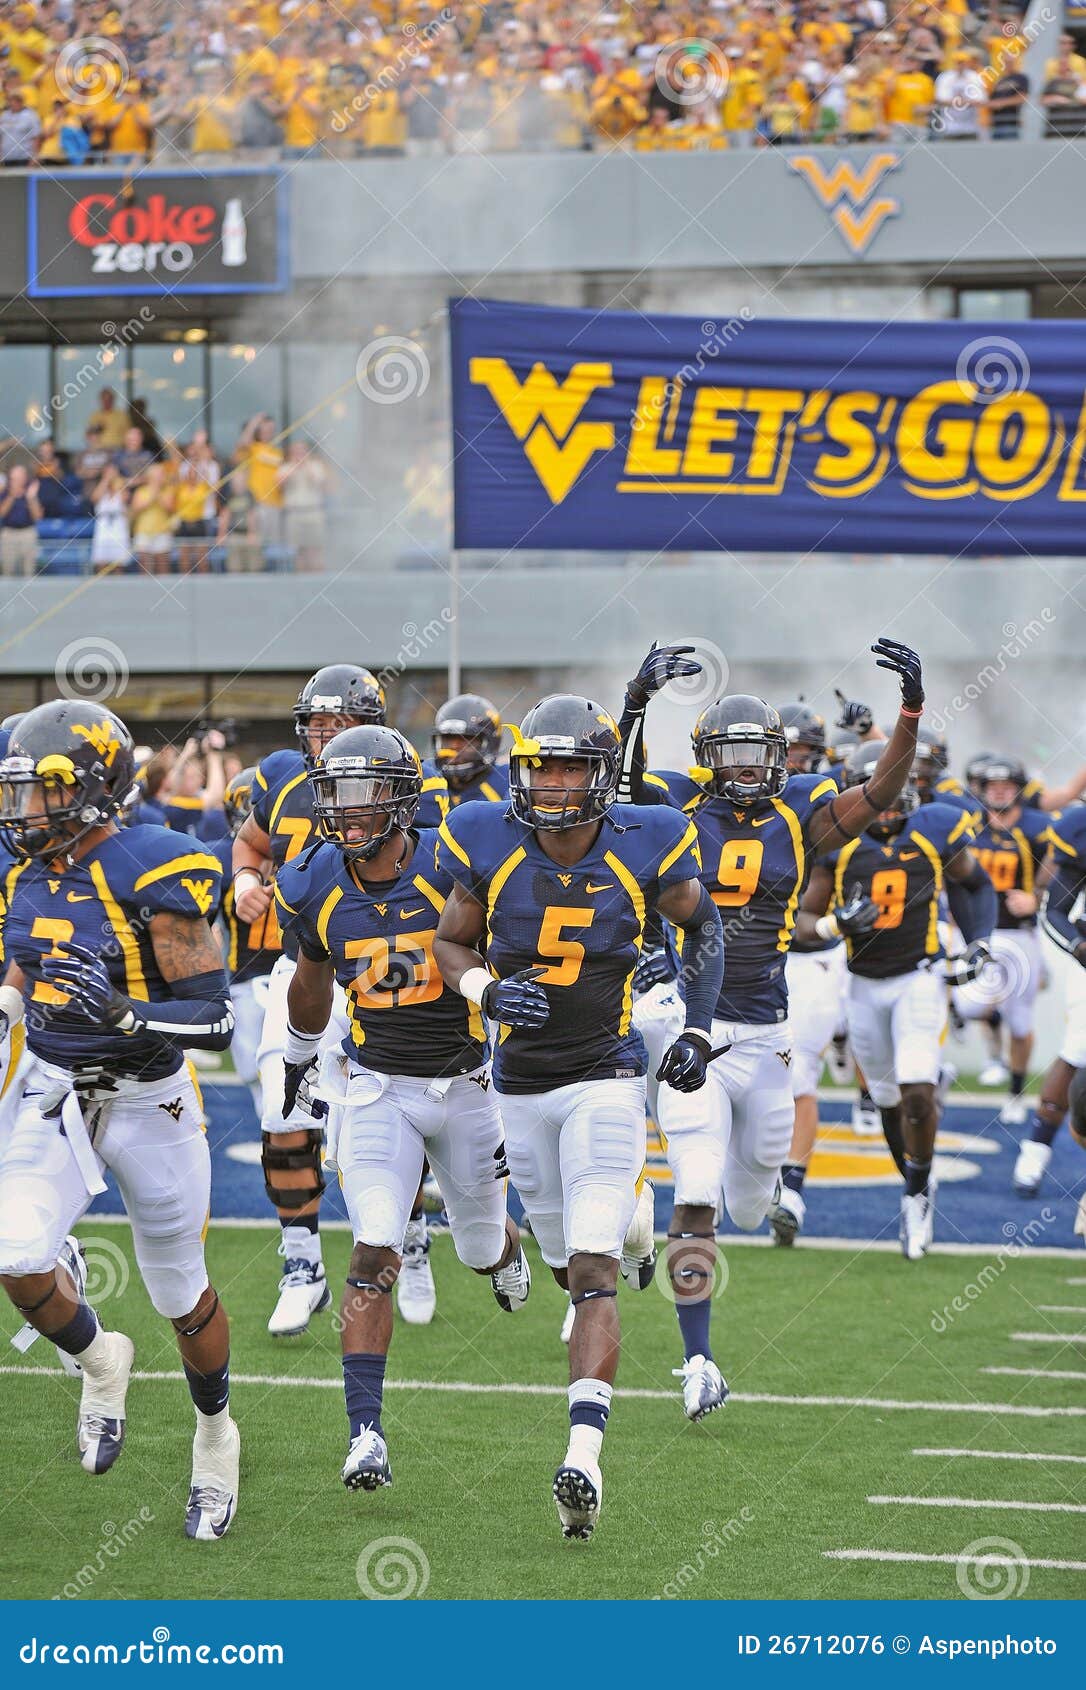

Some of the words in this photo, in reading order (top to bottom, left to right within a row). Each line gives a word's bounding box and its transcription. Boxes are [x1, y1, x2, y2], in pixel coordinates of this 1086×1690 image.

[69, 193, 216, 246] Coke
[92, 242, 194, 272] zero
[618, 375, 886, 496] LET'S
[896, 380, 1060, 498] GO
[710, 839, 764, 907] 9
[344, 929, 444, 1009] 23
[531, 906, 595, 987] 5
